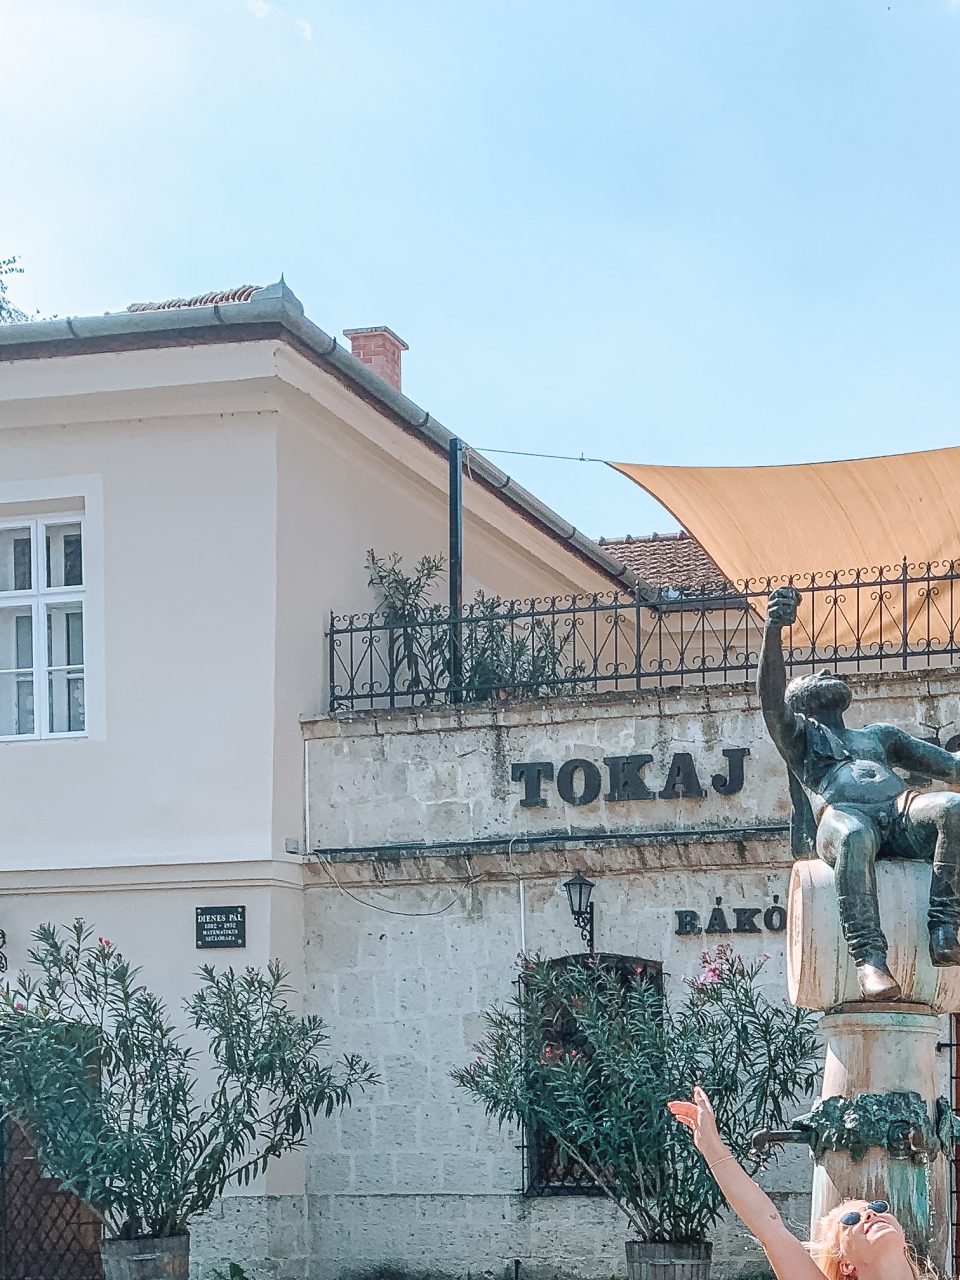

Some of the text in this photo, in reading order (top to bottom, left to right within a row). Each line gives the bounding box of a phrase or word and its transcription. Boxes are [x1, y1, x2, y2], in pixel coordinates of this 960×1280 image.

[510, 747, 750, 808] TOKAJ
[198, 912, 243, 922] DIENES PÁL
[675, 895, 788, 935] RÁKÓ
